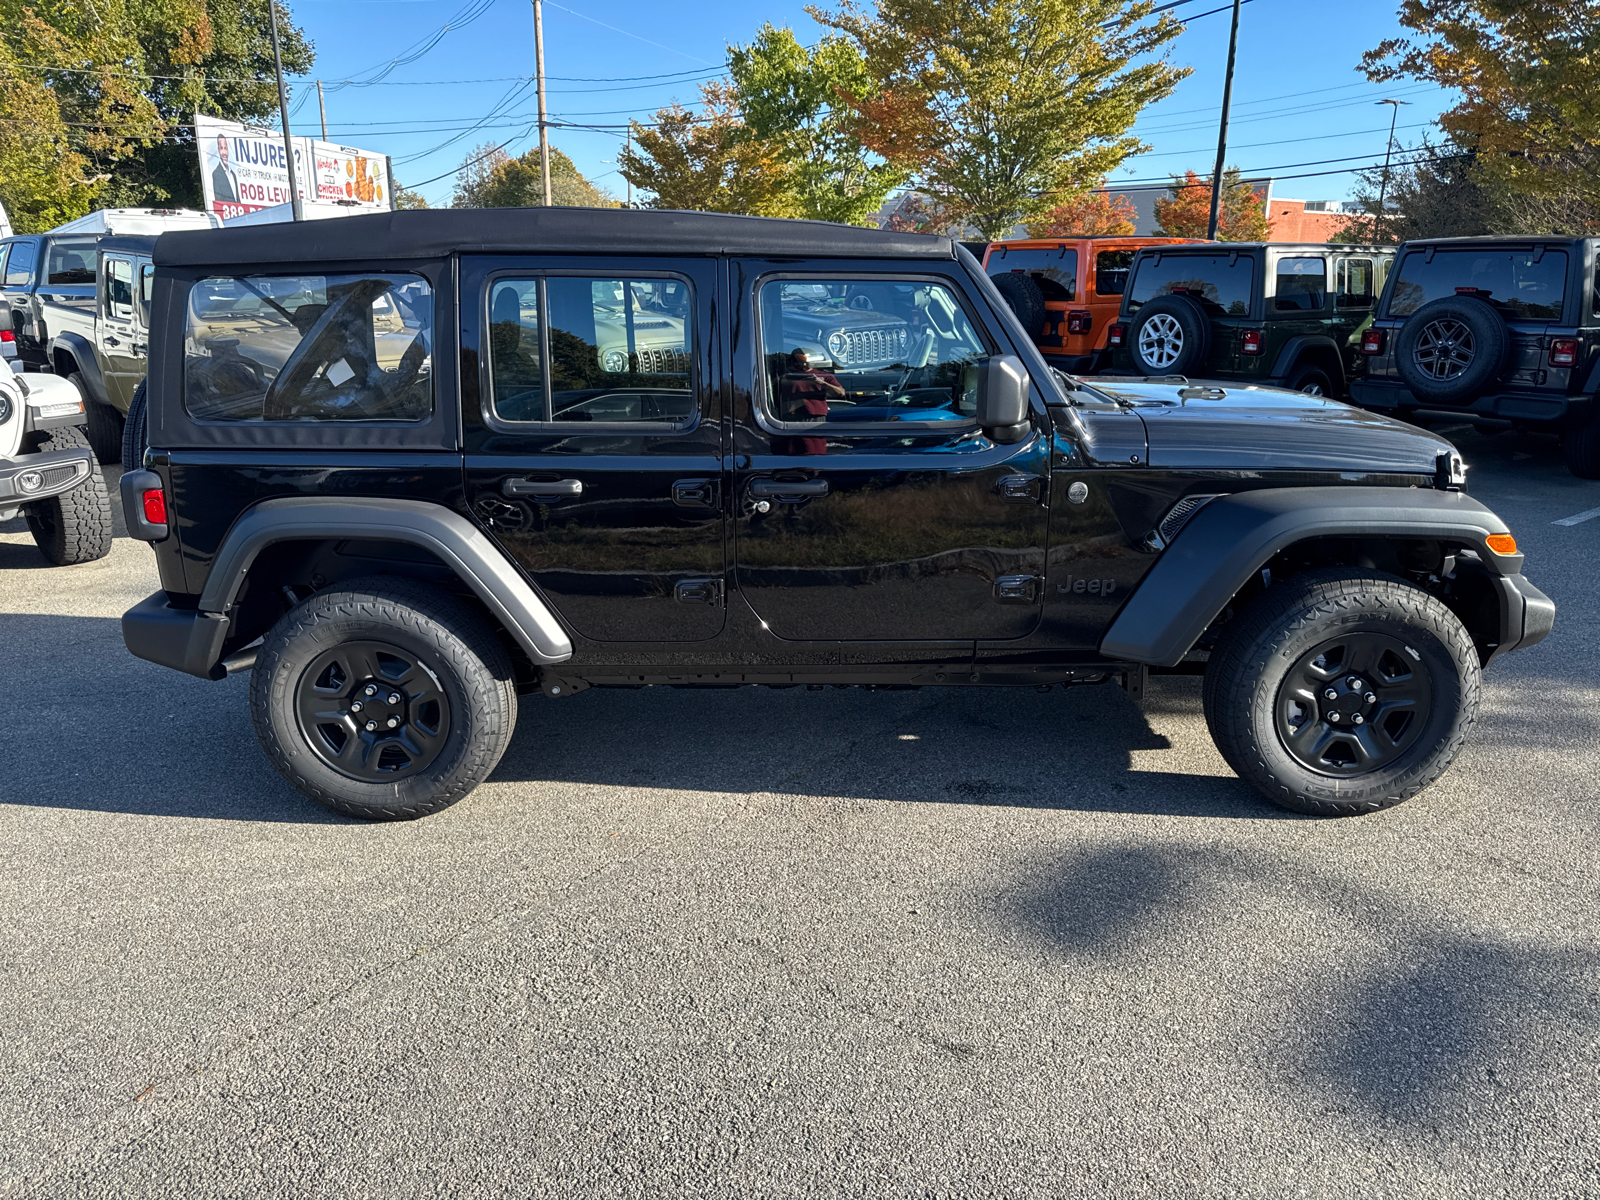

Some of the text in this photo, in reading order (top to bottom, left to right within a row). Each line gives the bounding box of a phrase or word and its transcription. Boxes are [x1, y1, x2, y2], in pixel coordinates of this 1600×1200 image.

[233, 137, 301, 171] INJURE?
[242, 168, 252, 178] CAR
[258, 171, 272, 181] TRUCK
[240, 183, 304, 204] ROB LEVIE
[318, 184, 344, 196] CHICKEN
[1056, 574, 1116, 597] Jeep
